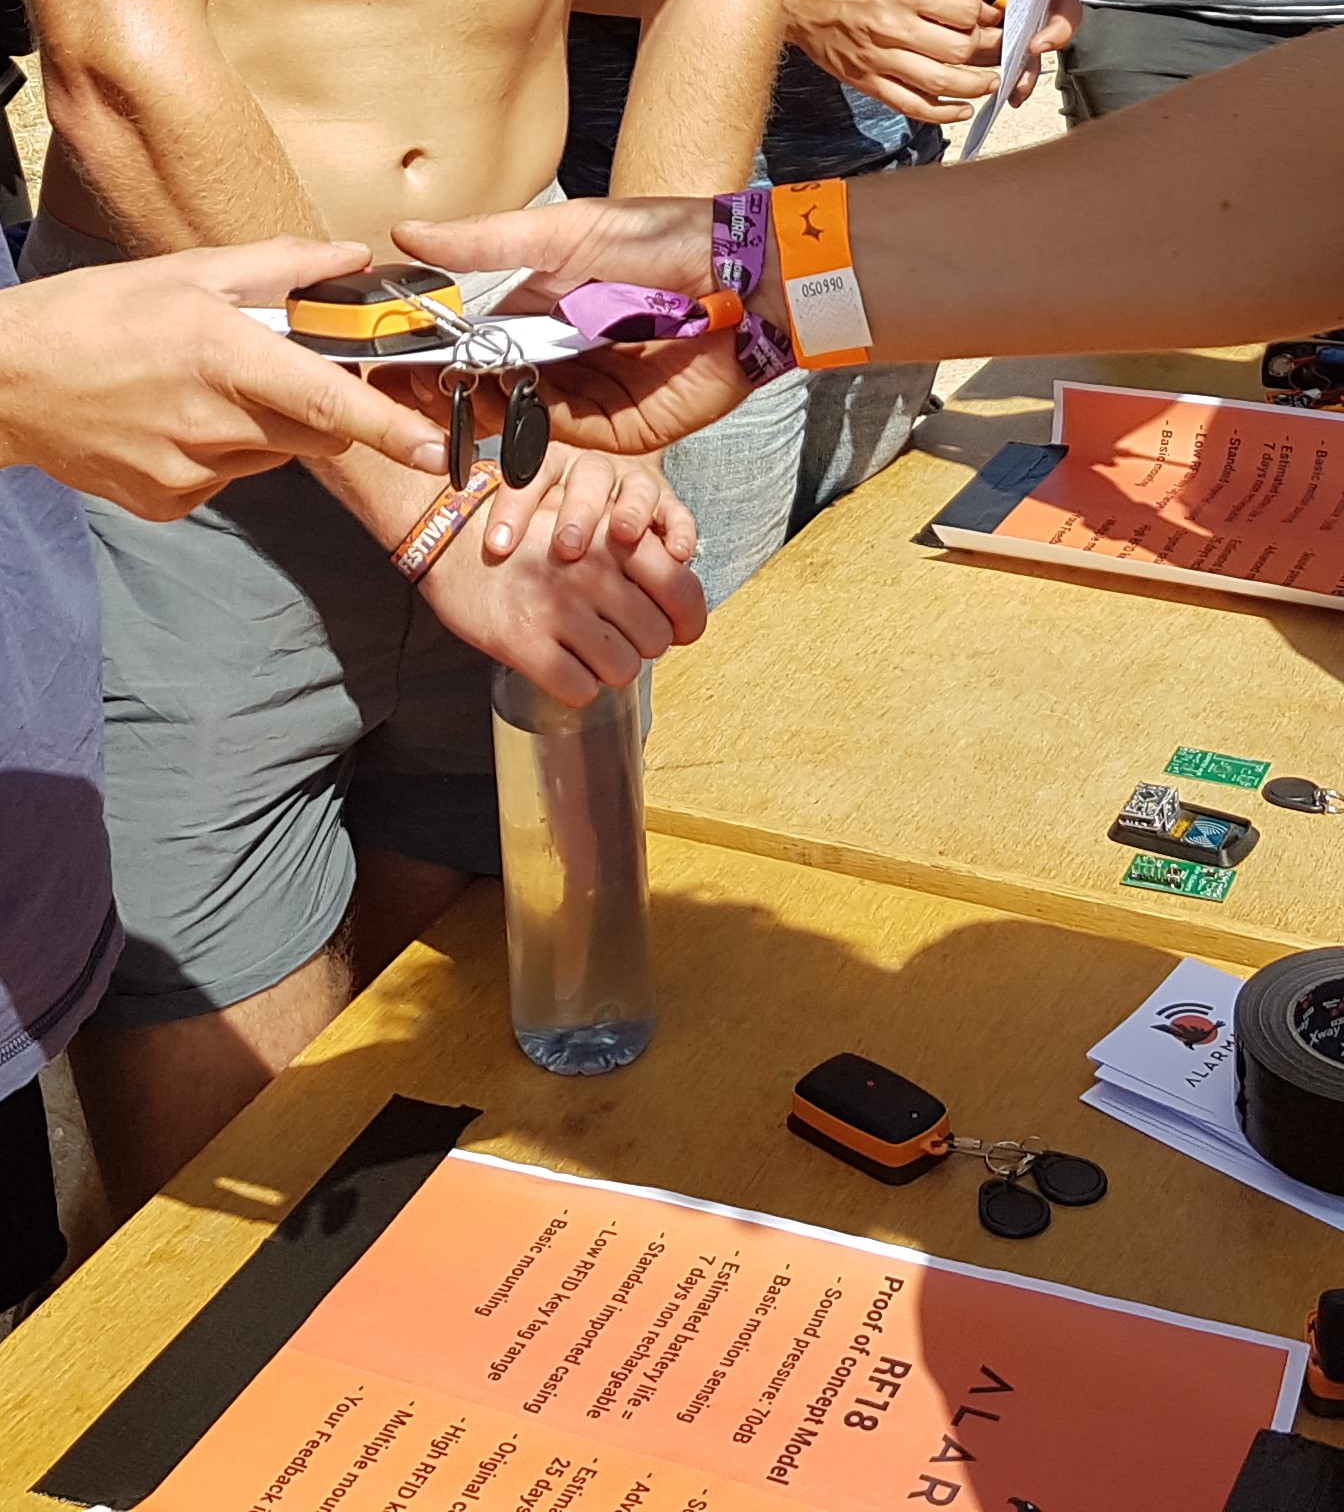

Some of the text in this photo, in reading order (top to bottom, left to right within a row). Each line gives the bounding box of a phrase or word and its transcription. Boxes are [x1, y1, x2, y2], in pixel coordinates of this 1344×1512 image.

[731, 195, 746, 241] TUBORG
[801, 276, 844, 299] 066050
[1154, 430, 1173, 464] Basic
[1193, 433, 1208, 460] Low
[1263, 442, 1276, 451] 7
[1311, 449, 1328, 481] Basic
[398, 506, 458, 575] FESTIVAL
[1309, 1025, 1341, 1046] Xway
[474, 1219, 568, 1317] Basic mounting
[487, 1230, 617, 1381] Low RFID key tag range
[682, 1262, 740, 1333] Estimated
[523, 1242, 665, 1414] Standard imported casing
[586, 1256, 716, 1419] 7 days non rechargeable
[676, 1275, 791, 1423] Basic motion sensing
[643, 1334, 695, 1383] battery
[733, 1288, 842, 1444] Sound pressure: 70dB
[766, 1276, 904, 1485] Proof of concept Model
[324, 1397, 364, 1429] Your
[627, 1384, 657, 1407] life
[844, 1356, 912, 1431] RF18
[353, 1410, 414, 1470] Multiple
[426, 1425, 466, 1459] High
[260, 1430, 332, 1503] Feedback
[398, 1462, 437, 1499] RFID
[461, 1442, 517, 1500] Original
[545, 1457, 571, 1478] 25
[614, 1481, 650, 1512] Adv
